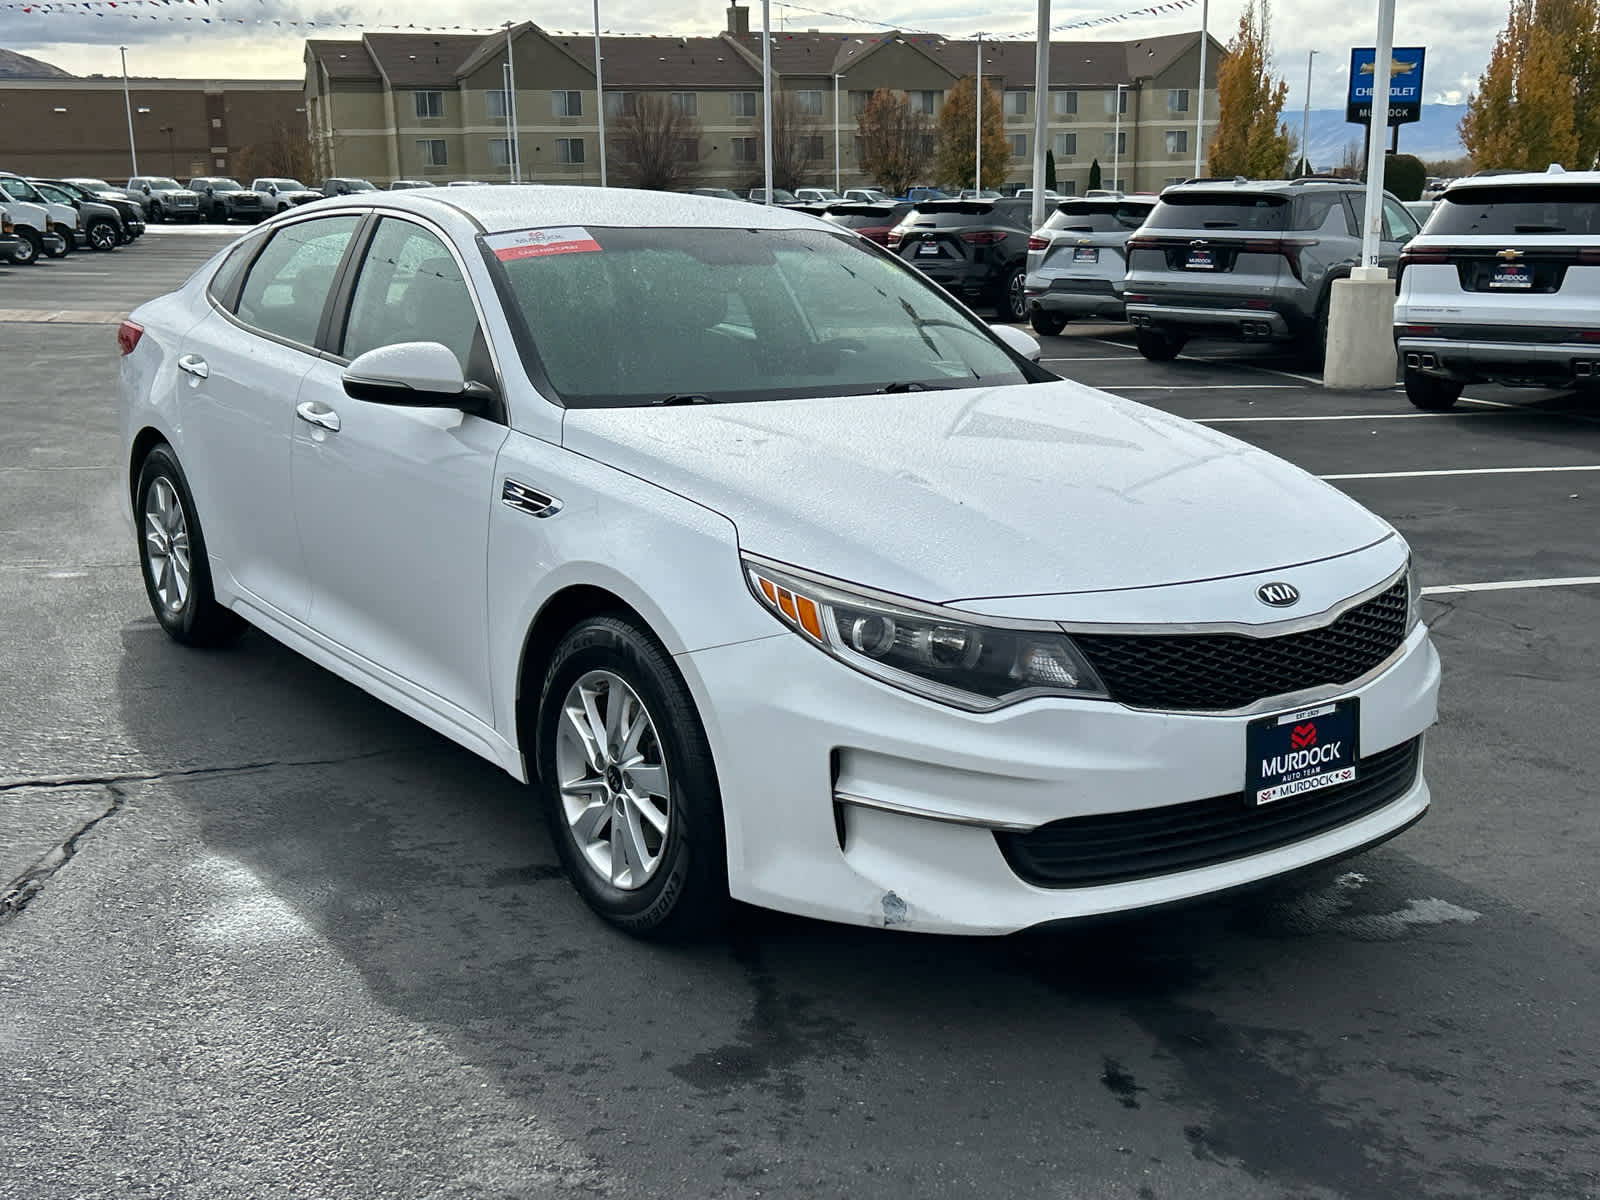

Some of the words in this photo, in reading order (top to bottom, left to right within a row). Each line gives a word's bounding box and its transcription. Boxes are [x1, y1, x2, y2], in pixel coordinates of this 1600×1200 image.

[1355, 87, 1416, 96] CHEOLET
[1359, 108, 1408, 117] MUOCK
[1370, 255, 1378, 265] 13
[1260, 584, 1298, 602] KIA
[1262, 740, 1341, 778] MURDOCK
[1282, 771, 1301, 783] AUTO
[1303, 766, 1321, 777] TEAM
[1280, 774, 1334, 796] MURDOCK
